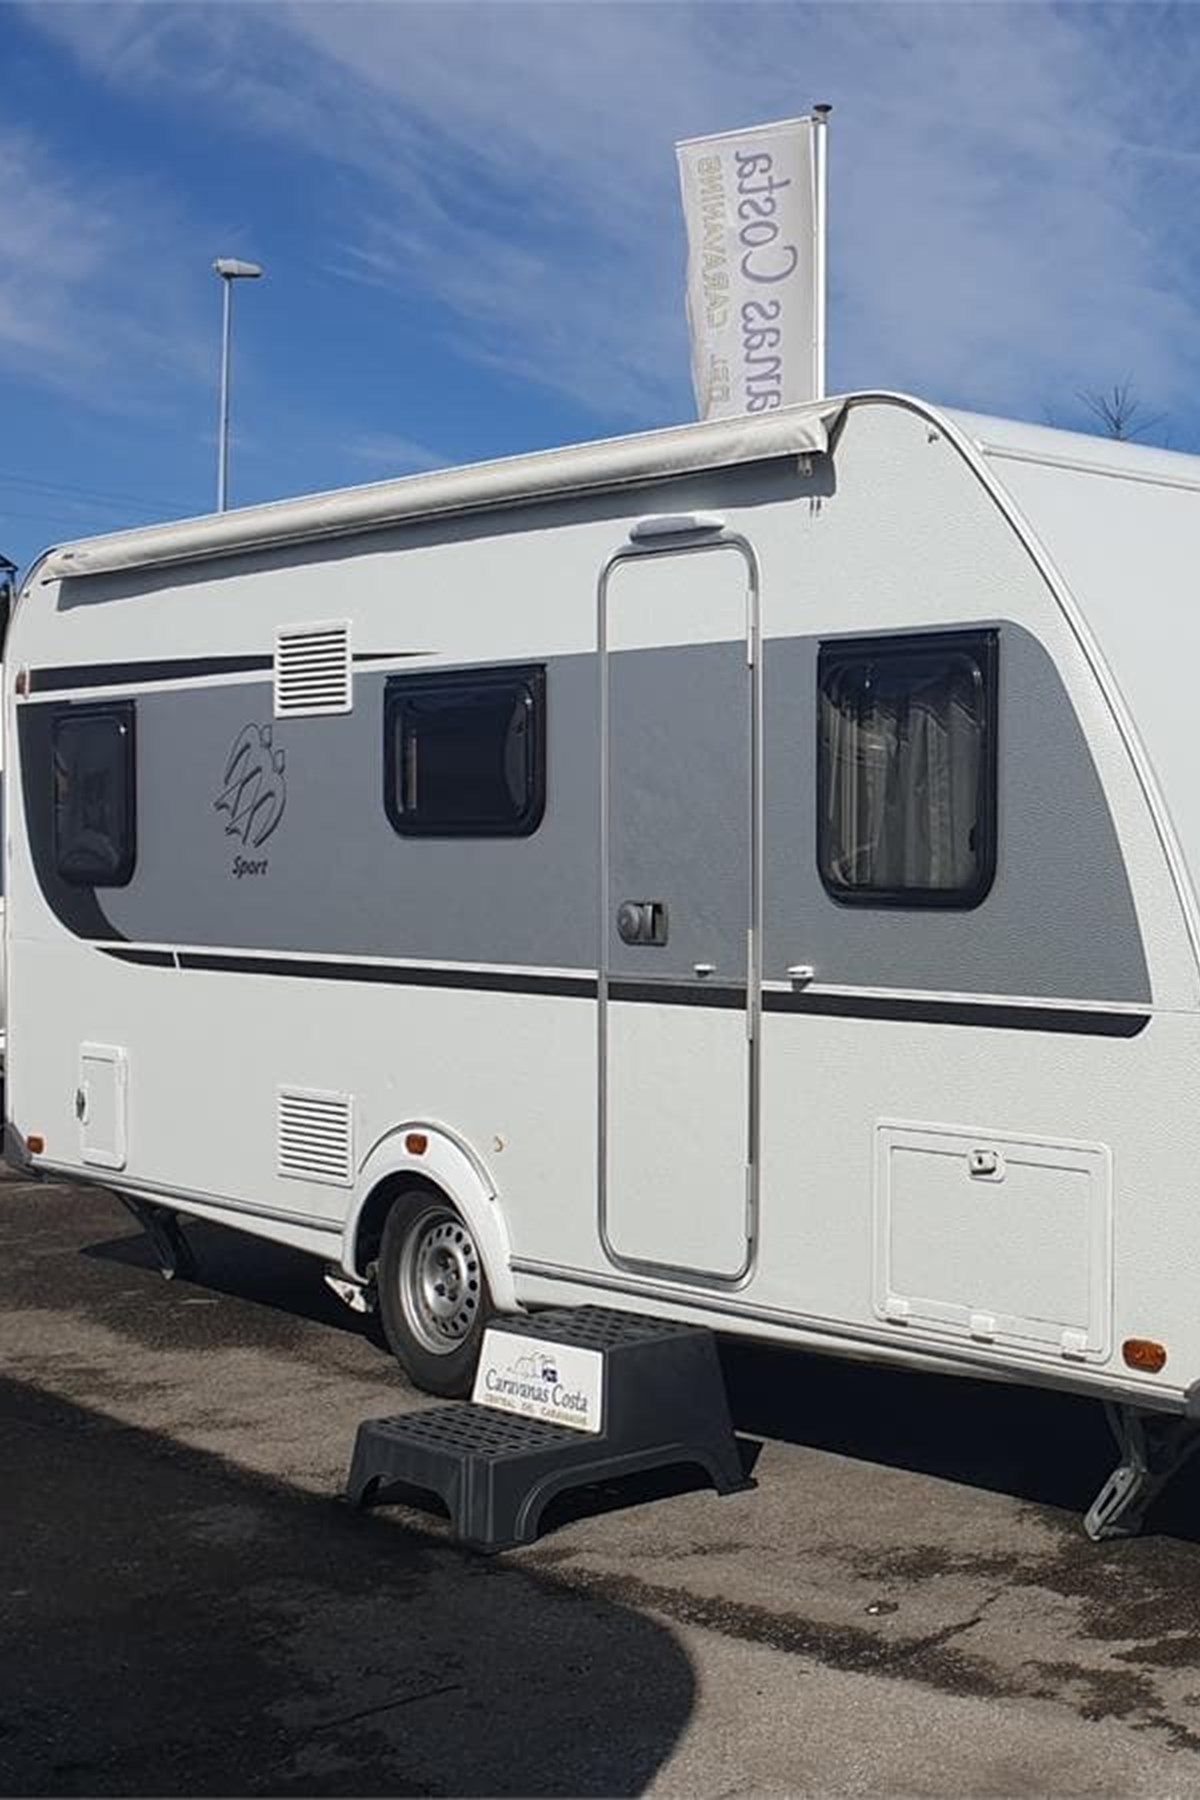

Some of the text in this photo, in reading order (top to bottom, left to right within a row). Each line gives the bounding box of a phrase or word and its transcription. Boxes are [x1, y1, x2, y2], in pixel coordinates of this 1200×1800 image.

[232, 855, 268, 878] Sport
[485, 1368, 588, 1413] Caravanas Costa
